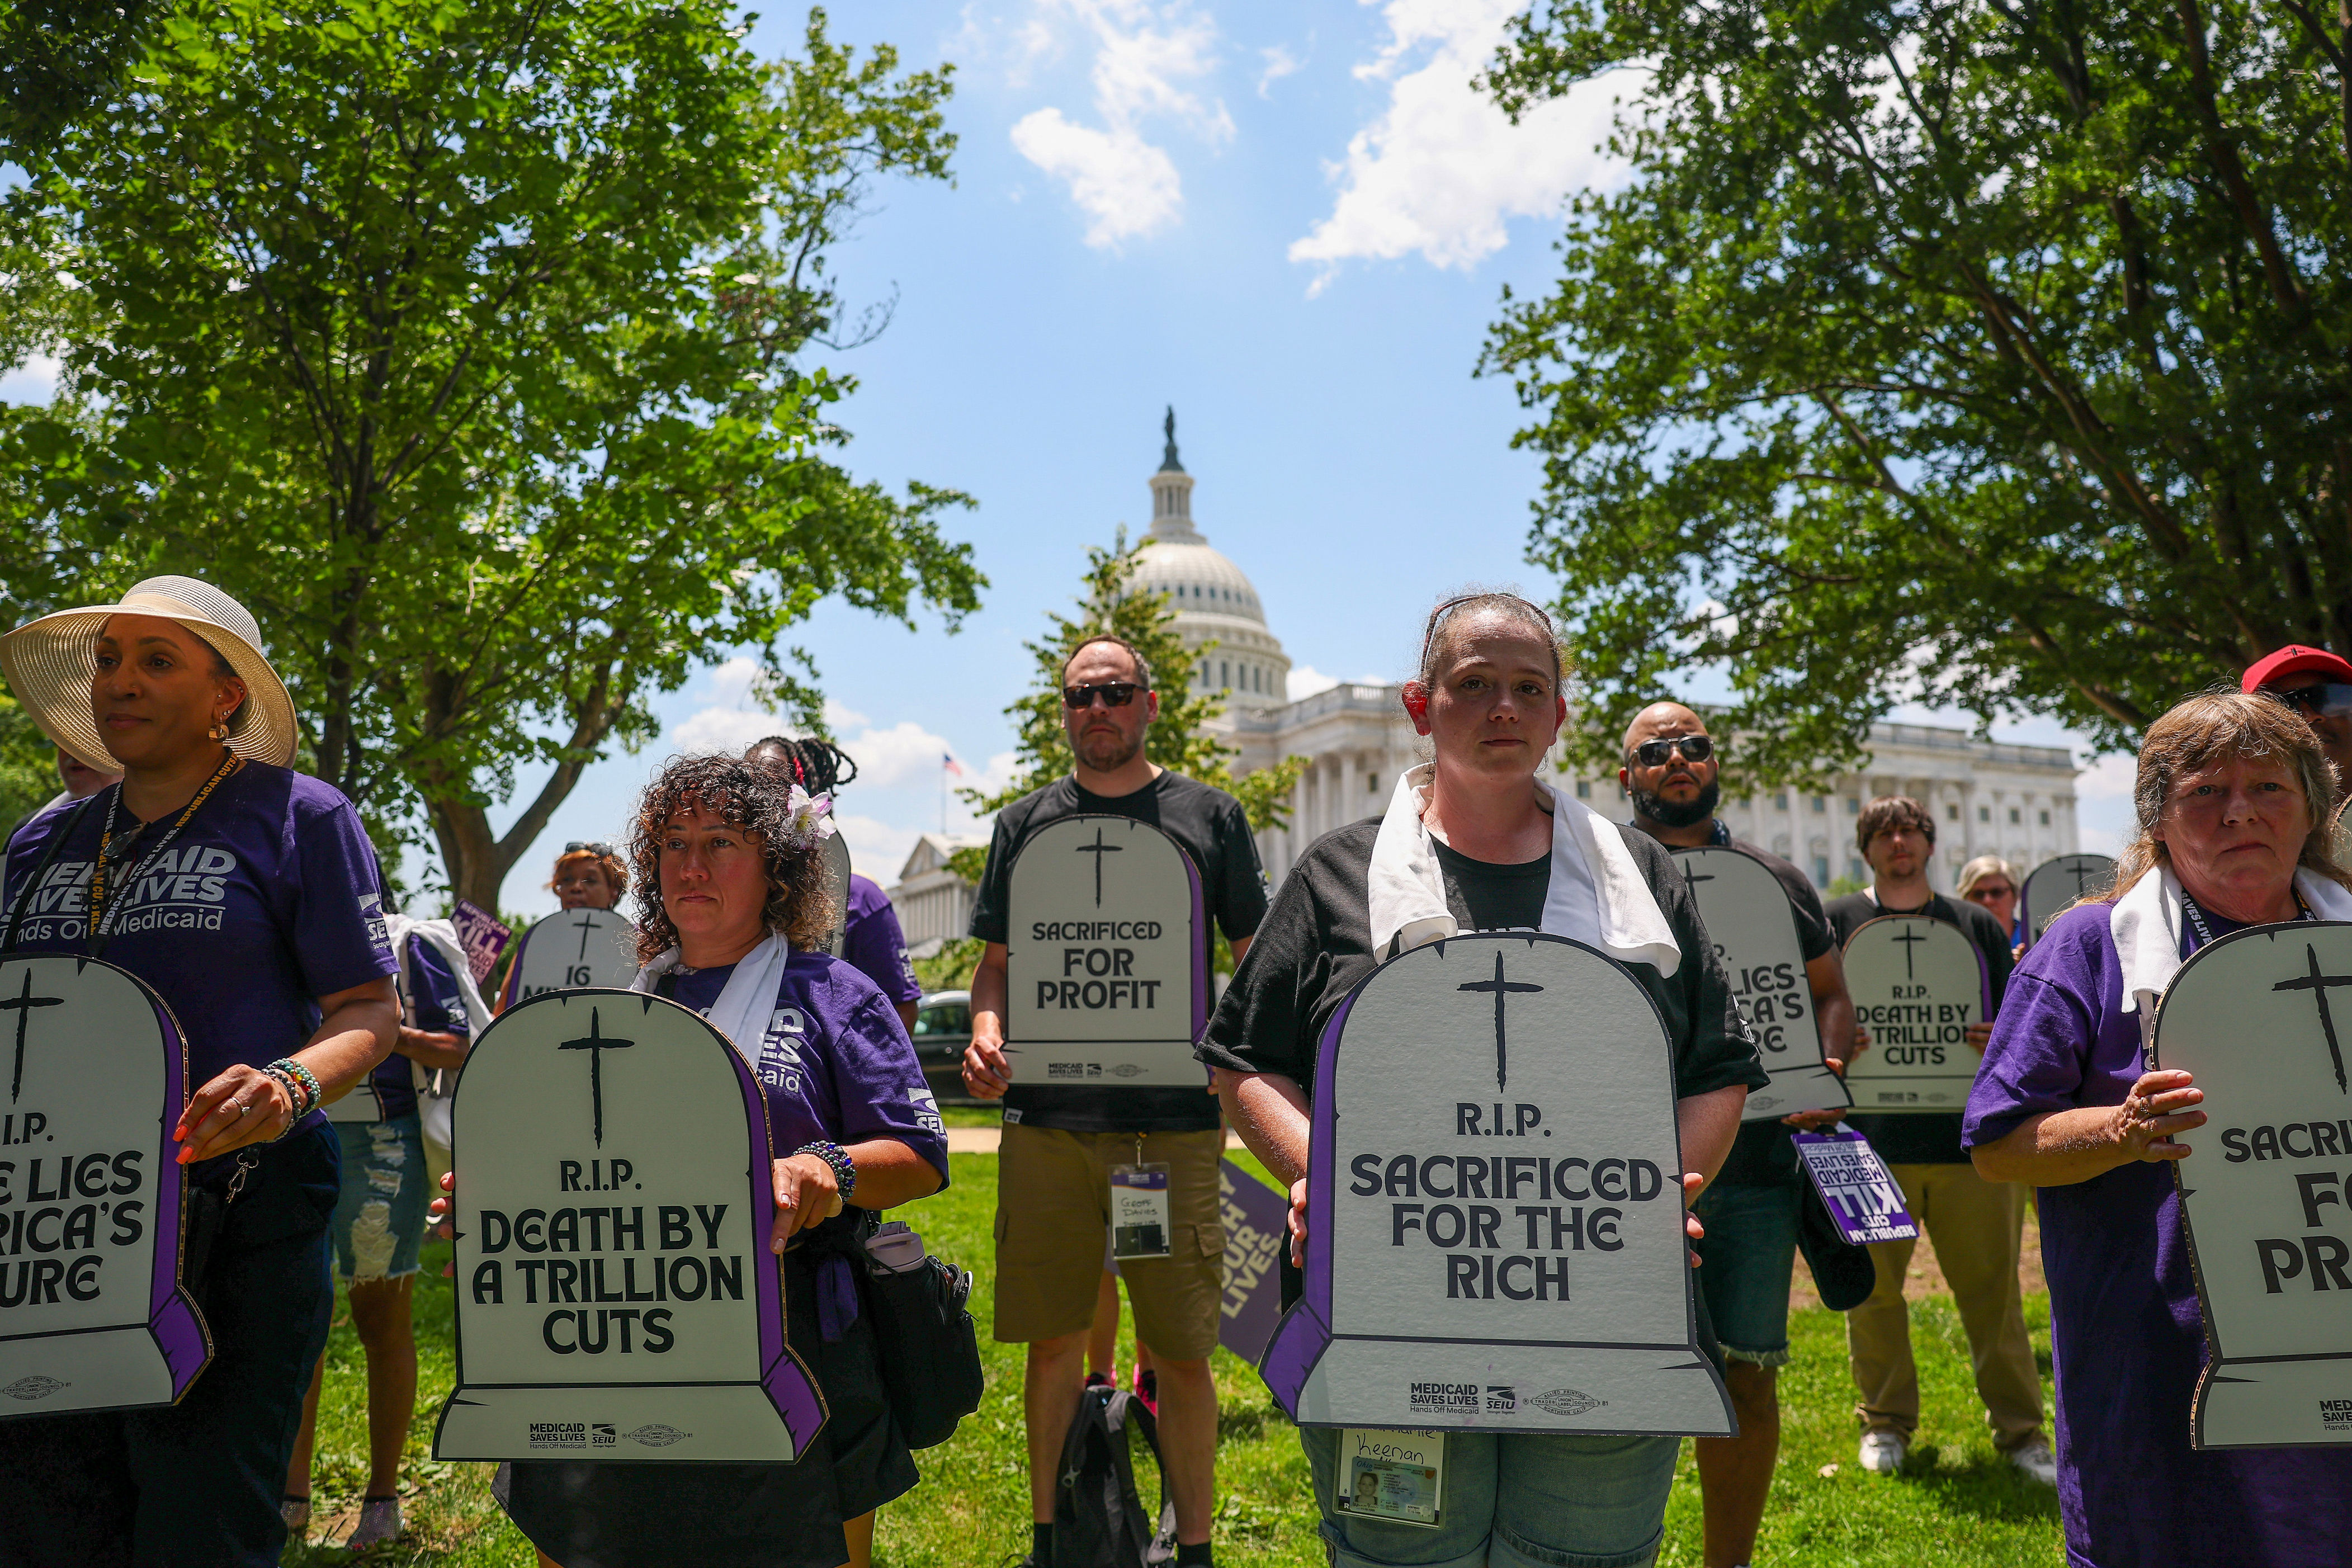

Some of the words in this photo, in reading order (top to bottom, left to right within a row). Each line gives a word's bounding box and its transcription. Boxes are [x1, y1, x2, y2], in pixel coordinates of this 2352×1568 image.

[98, 884, 131, 935] MEDICAID
[129, 854, 155, 883] SAVES
[175, 776, 223, 827] REPUBLICAN
[218, 757, 235, 776] CUTS
[16, 846, 237, 898] MEIAID
[0, 887, 95, 922] AVE
[2181, 892, 2201, 921] SAVES
[0, 920, 52, 948] nds
[114, 908, 224, 936] Medicaid
[451, 914, 498, 958] KILL
[1032, 922, 1162, 941] SACRIFICED
[373, 941, 390, 949] Stronger
[566, 965, 590, 985] 16
[1064, 948, 1134, 976] FOR
[1037, 981, 1161, 1009] PROFIT
[1892, 985, 1931, 999] R.I.P.
[1856, 1005, 1931, 1023] DEATH
[1939, 1005, 1970, 1023] BY
[1885, 1047, 1945, 1064] CUTS
[1456, 1103, 1551, 1137] R.I.P.
[1809, 1155, 1843, 1168] LIVES
[1841, 1154, 1874, 1167] SAVES
[26, 1150, 145, 1202] LIES
[560, 1159, 642, 1192] R.I.P.
[1350, 1154, 1662, 1201] SACRIFICED
[1817, 1167, 1884, 1184] MEDICAID
[1823, 1182, 1904, 1218] KILL
[480, 1206, 645, 1253] DEATH
[658, 1204, 729, 1250] BY
[1392, 1203, 1501, 1248] FOR
[1515, 1206, 1624, 1251] THE
[1848, 1224, 1917, 1243] REPUBLICAN
[1861, 1216, 1890, 1229] CUTS
[473, 1259, 504, 1304] A
[516, 1255, 744, 1303] TRILLION
[1220, 1232, 1282, 1319] LIVES
[1446, 1254, 1570, 1301] RICH
[542, 1309, 674, 1354] CUTS
[15, 1378, 30, 1386] ALLIED
[1411, 1383, 1478, 1395] MEDICAID
[1564, 1390, 1586, 1399] PRINTING
[1410, 1395, 1445, 1404] SAVES
[1447, 1396, 1479, 1405] LIVES
[1486, 1401, 1515, 1409] SEIU
[1544, 1406, 1570, 1415] NORTHERN
[530, 1423, 585, 1433] MEDICAID
[1357, 1433, 1424, 1465] Keenan
[1357, 1460, 1373, 1470] Ohio
